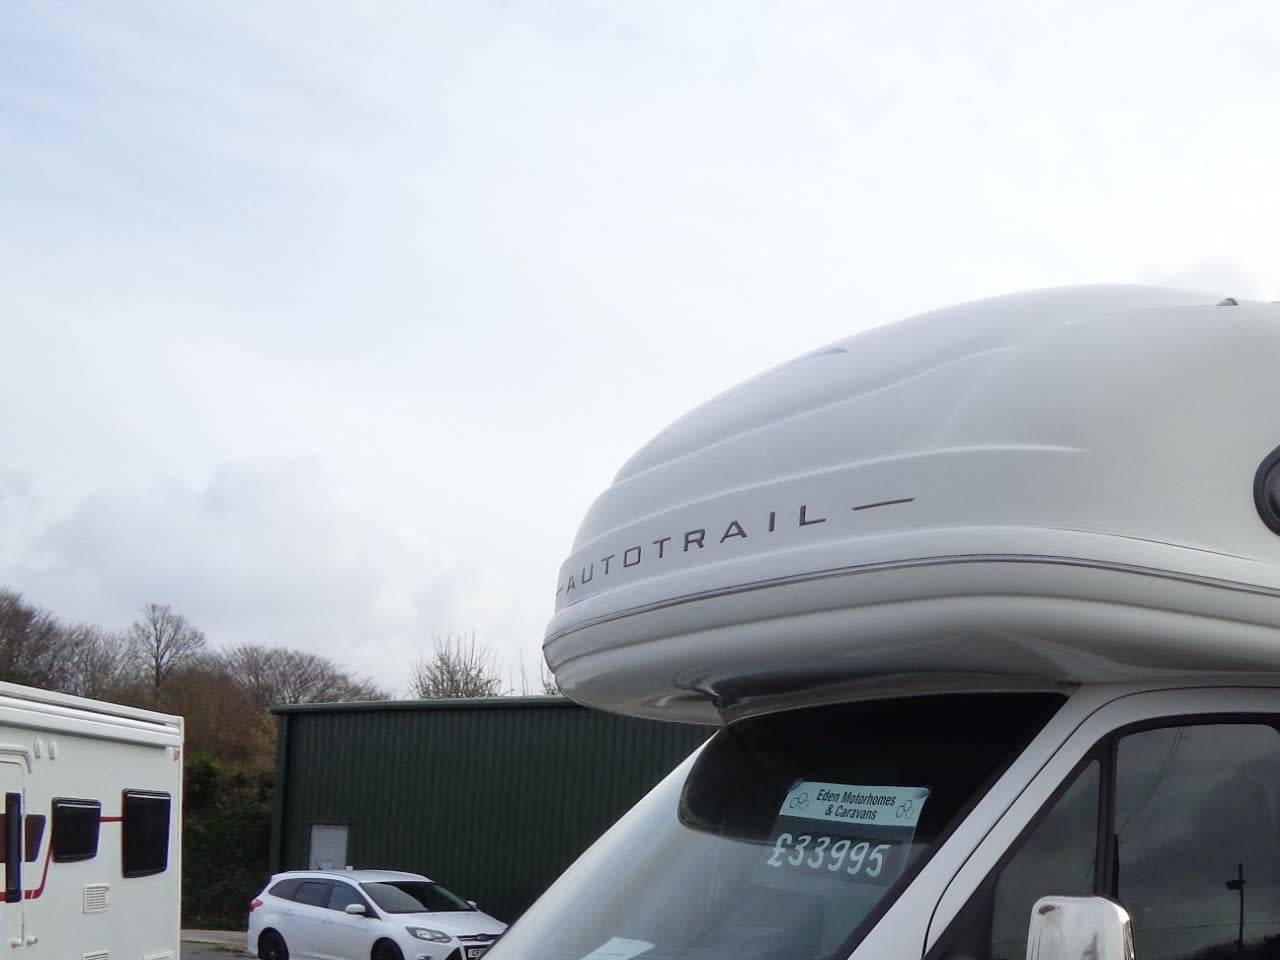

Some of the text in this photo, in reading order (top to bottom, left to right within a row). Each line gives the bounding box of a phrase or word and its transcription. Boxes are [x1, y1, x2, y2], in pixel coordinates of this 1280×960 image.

[565, 504, 827, 595] AUTOTRAIL
[816, 789, 897, 807] Eden Motorhomes
[825, 804, 878, 821] & Caravans
[767, 833, 892, 877] £33995
